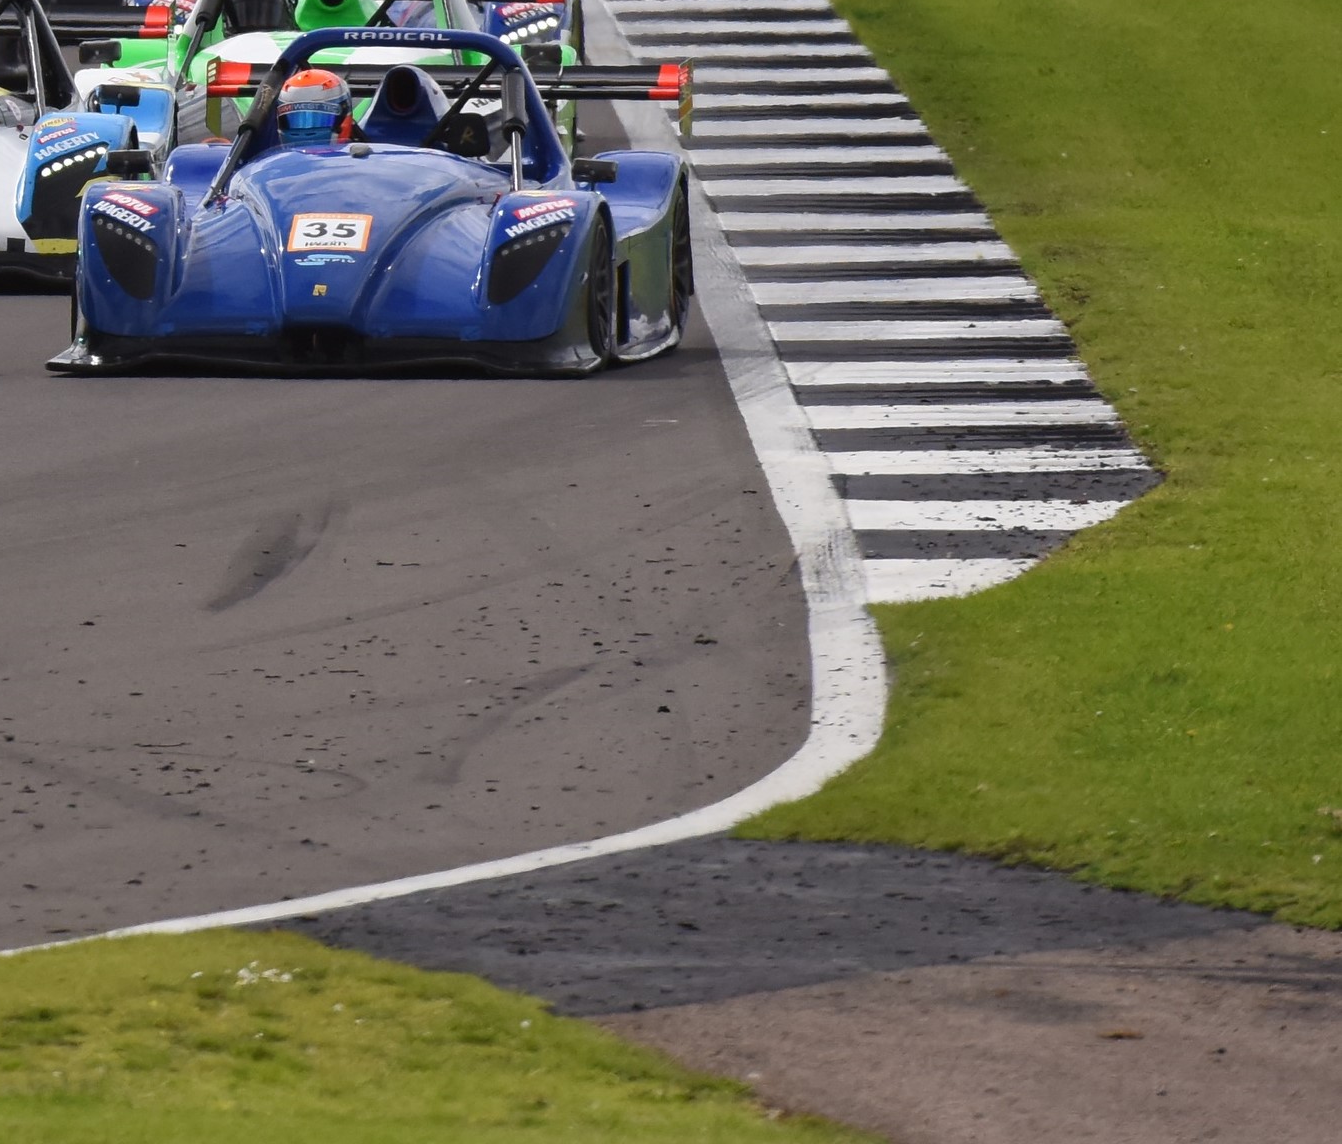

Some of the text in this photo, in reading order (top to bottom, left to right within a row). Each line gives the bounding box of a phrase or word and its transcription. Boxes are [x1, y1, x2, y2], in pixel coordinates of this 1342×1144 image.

[343, 32, 451, 41] RADICAL
[34, 132, 100, 161] HAGERTY
[92, 200, 156, 232] HAGERTY
[105, 193, 155, 217] MOTUL
[517, 199, 577, 219] MOTUL
[301, 222, 357, 239] 35
[505, 208, 575, 238] HAGERTY
